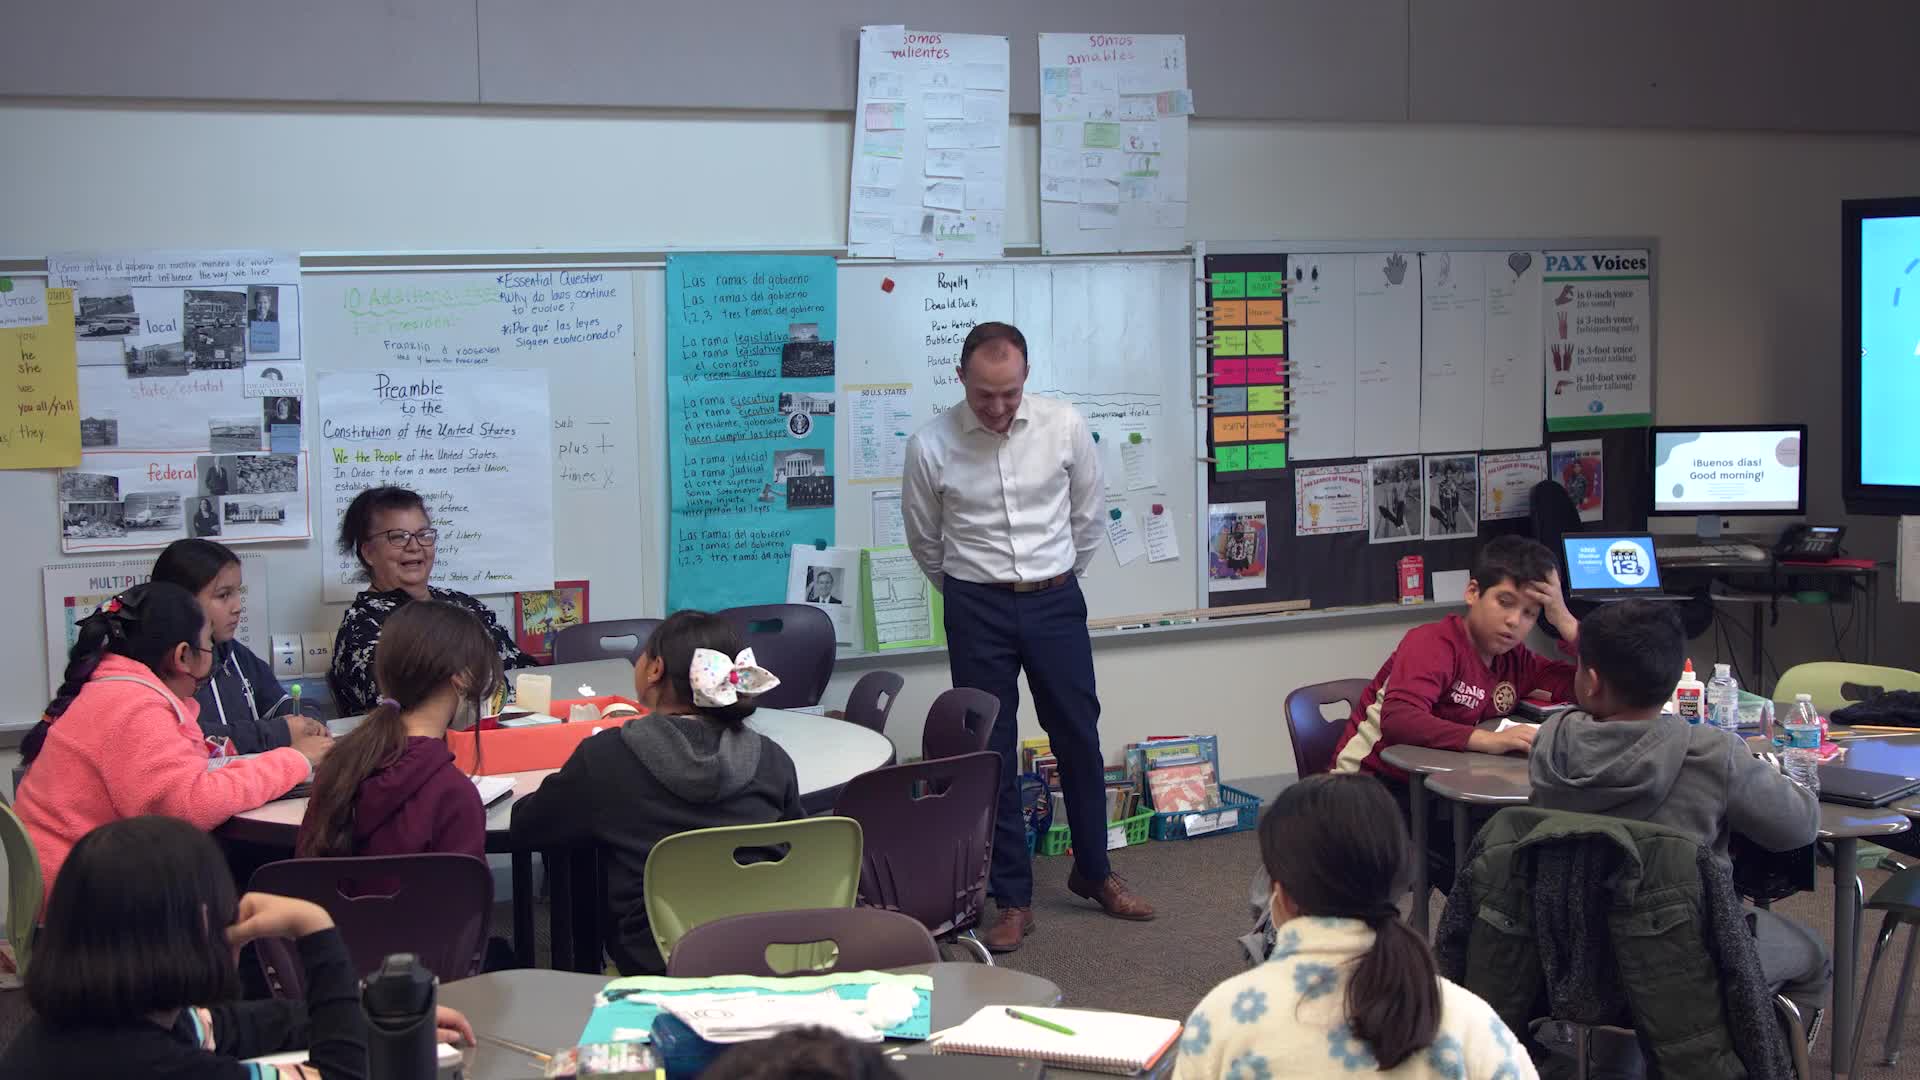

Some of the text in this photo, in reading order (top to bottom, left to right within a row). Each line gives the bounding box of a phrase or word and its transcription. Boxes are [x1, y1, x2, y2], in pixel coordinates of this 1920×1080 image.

[1545, 254, 1647, 272] PAX Voices
[504, 271, 604, 288] Essential Question
[682, 272, 809, 290] Las ramas del gobierno
[937, 272, 969, 293] Royalty
[532, 291, 545, 302] do
[575, 288, 617, 299] continue
[682, 290, 808, 309] Las ramas del gobierno
[512, 304, 524, 315] to
[722, 304, 825, 320] tres ramas del gobierno
[147, 319, 177, 334] local
[556, 320, 571, 332] las
[576, 318, 600, 330] leyes
[681, 330, 789, 348] La rama legislativa
[21, 349, 35, 361] he
[682, 349, 697, 360] La
[703, 350, 729, 359] rama
[927, 355, 951, 368] Panda
[18, 363, 41, 374] she
[696, 359, 759, 371] el congreso
[373, 373, 444, 399] Preamble
[683, 372, 699, 386] que
[933, 375, 959, 386] Wate
[401, 401, 443, 414] to the
[683, 395, 696, 409] La
[700, 396, 726, 405] rama
[18, 403, 33, 416] you
[684, 408, 698, 420] La
[705, 408, 731, 417] rama
[323, 419, 517, 440] Constitution of the United States
[554, 417, 574, 429] sub
[685, 421, 692, 432] el
[19, 424, 45, 443] they
[684, 433, 711, 445] hacen
[333, 447, 464, 464] We the People of the United
[559, 441, 589, 457] plus
[684, 451, 768, 468] La rama judicial
[1693, 458, 1762, 468] ¡Buenos días!
[146, 463, 197, 481] federal
[333, 463, 482, 479] In Order to form a more perfect
[560, 465, 597, 482] times
[683, 465, 765, 479] La rama judicial
[1690, 471, 1764, 483] Good morning!
[684, 477, 763, 489] el corte suprema
[686, 487, 712, 498] Sonia
[750, 504, 770, 516] leyes
[456, 531, 482, 541] Liberty
[680, 527, 791, 543] Las ramas del gobierno
[701, 542, 730, 550] ramas
[736, 540, 747, 549] del
[751, 540, 784, 553] gobierno
[711, 552, 758, 563] tres ramas
[1613, 560, 1638, 574] 13
[89, 575, 152, 590] MULTIPLIC
[309, 648, 328, 656] 0.25
[284, 657, 293, 666] 4
